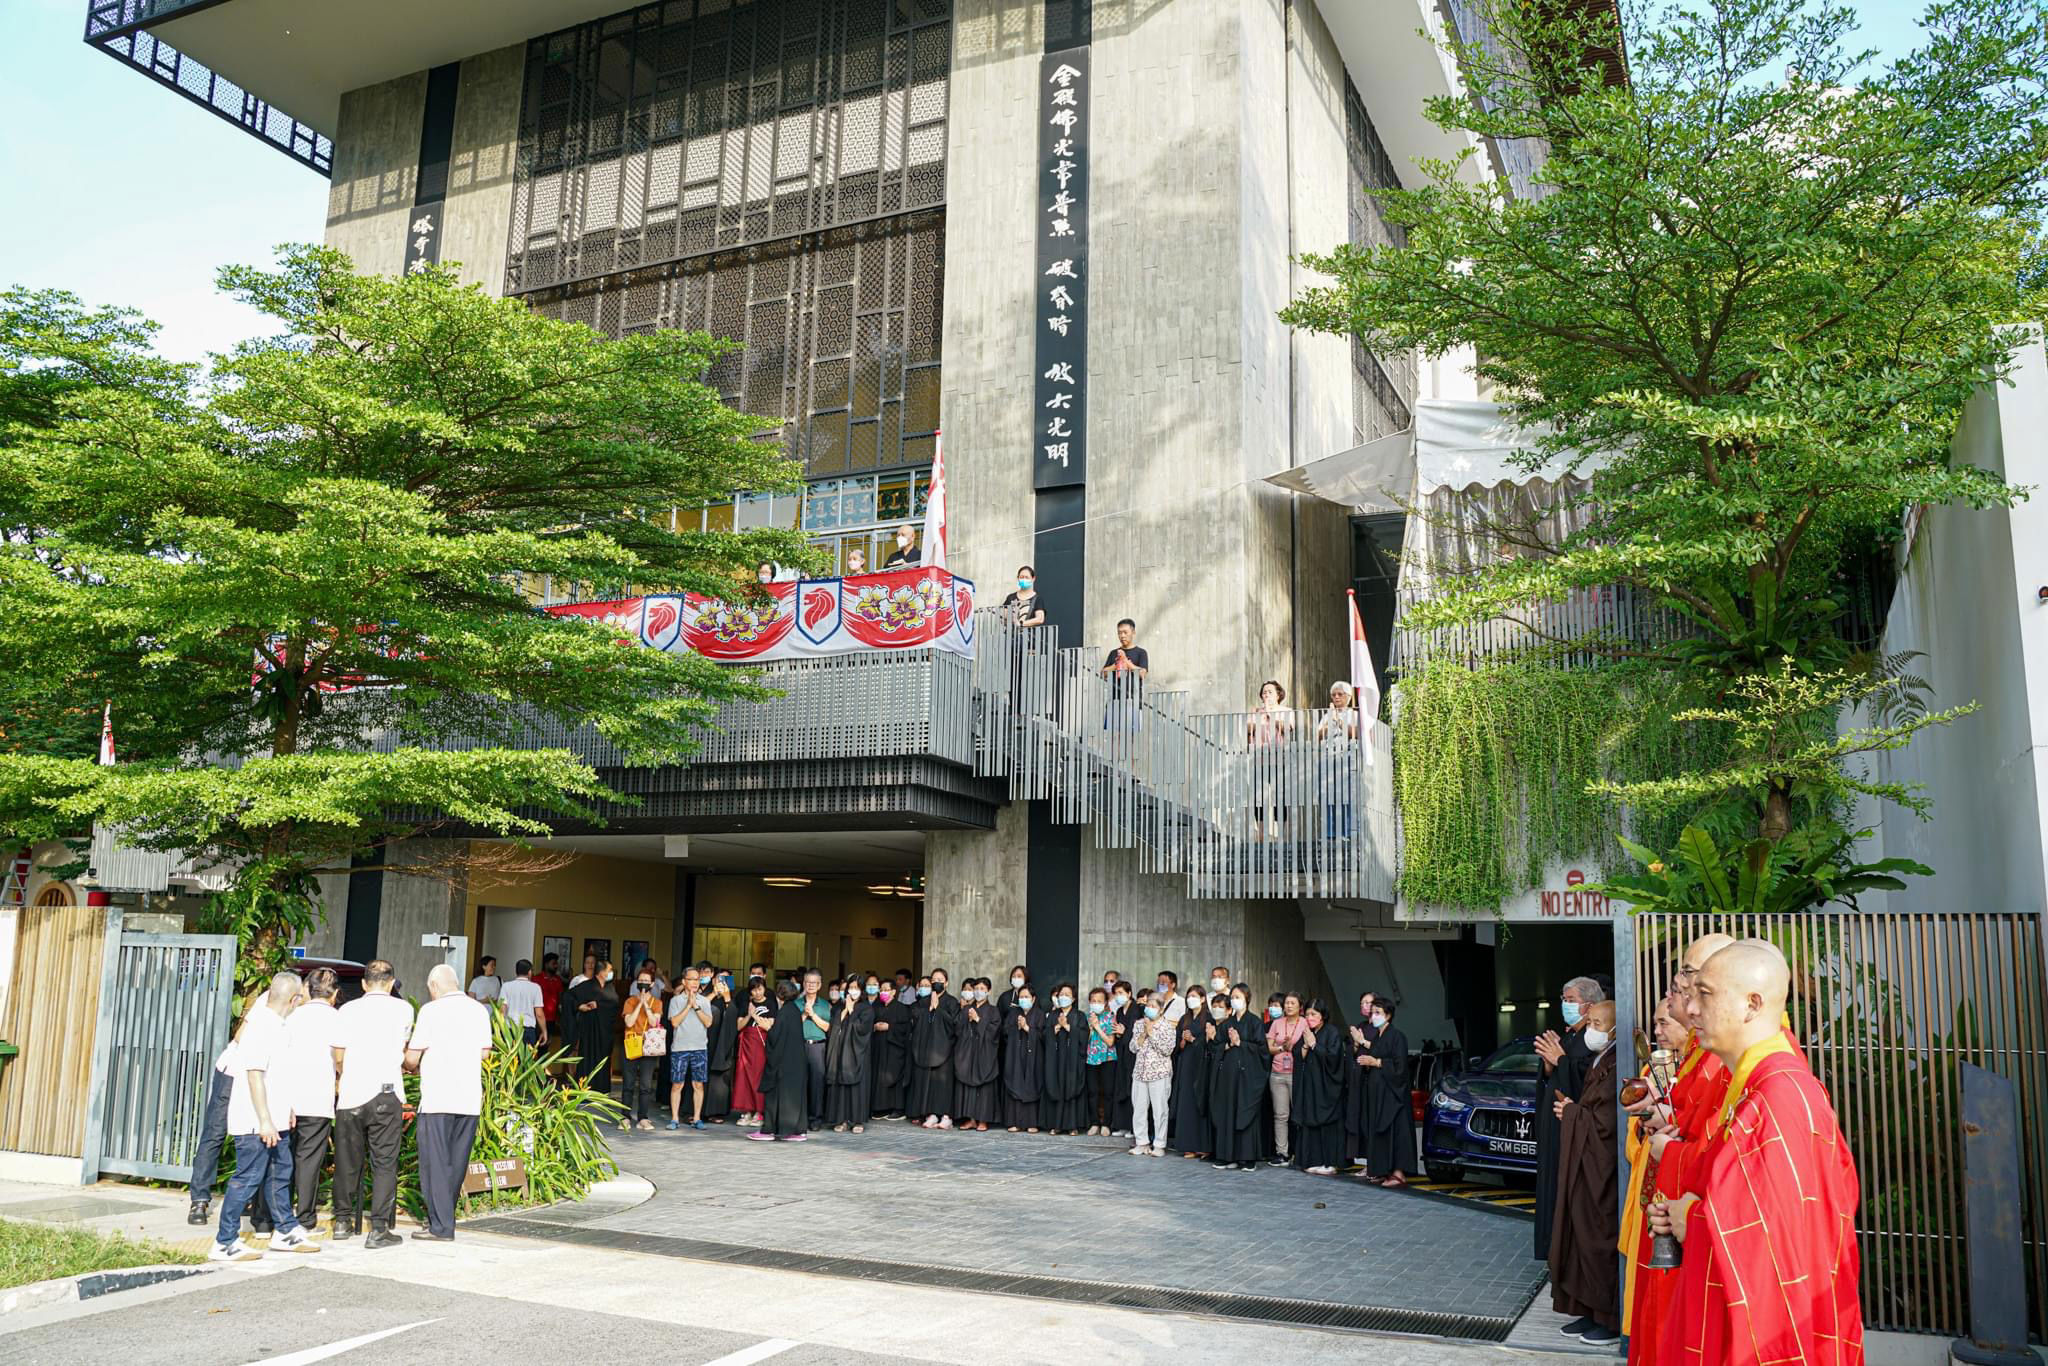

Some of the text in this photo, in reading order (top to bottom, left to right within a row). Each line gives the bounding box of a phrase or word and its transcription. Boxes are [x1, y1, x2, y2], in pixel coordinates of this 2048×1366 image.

[1043, 361, 1076, 468] 放大光明
[1541, 891, 1611, 917] NO ENTRY
